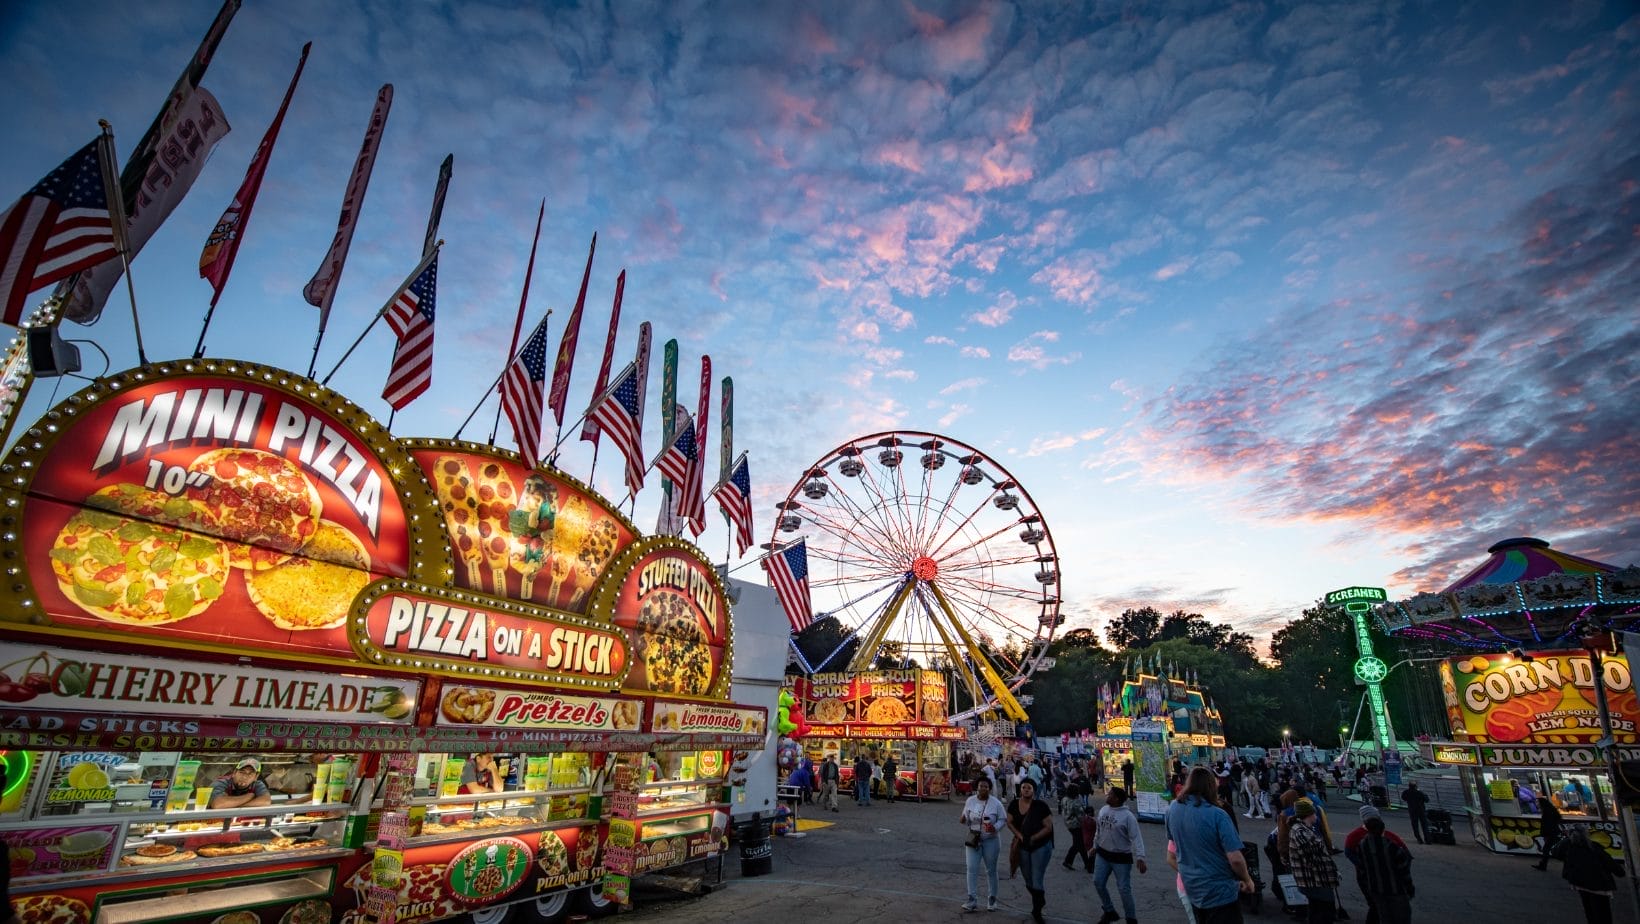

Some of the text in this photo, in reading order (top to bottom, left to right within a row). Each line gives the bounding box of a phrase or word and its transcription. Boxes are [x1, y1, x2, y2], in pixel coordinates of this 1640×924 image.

[92, 388, 382, 541] MINI PIZZA
[144, 459, 210, 494] 10"
[639, 557, 717, 638] STUFFED PIZZA
[1329, 588, 1383, 603] SCREAMER
[384, 596, 614, 674] PIZZA ON A STICK
[51, 658, 376, 713] CHERRY LIMEADE
[812, 672, 852, 686] SPIRAL
[922, 670, 946, 687] SPIRAL
[1464, 658, 1563, 712] CORN
[527, 694, 555, 703] JUMBO
[812, 685, 850, 699] SPUDS
[871, 683, 904, 698] FRIES
[922, 685, 945, 702] SPUDS
[496, 696, 607, 726] Pretzels
[681, 708, 742, 729] Lemonade
[1535, 708, 1622, 720] FRESH SQUEED
[0, 715, 65, 730] AD
[79, 717, 200, 734] STICKS
[237, 720, 353, 739] STUFFED
[360, 725, 420, 739] MEAT
[490, 731, 517, 742] 10"
[522, 731, 555, 742] MINI
[559, 732, 604, 743] PIZZAS
[112, 735, 276, 751] SQUEEZED
[285, 737, 409, 751] LEMONADE
[1115, 741, 1134, 749] CREA
[60, 752, 125, 766] FROZEN
[1439, 751, 1472, 762] LEMONADE
[1489, 748, 1595, 766] JUMBO
[50, 787, 117, 801] LEMONADE
[657, 849, 677, 863] PIZZA
[535, 873, 565, 893] PIZZA
[395, 900, 435, 922] SLICES
